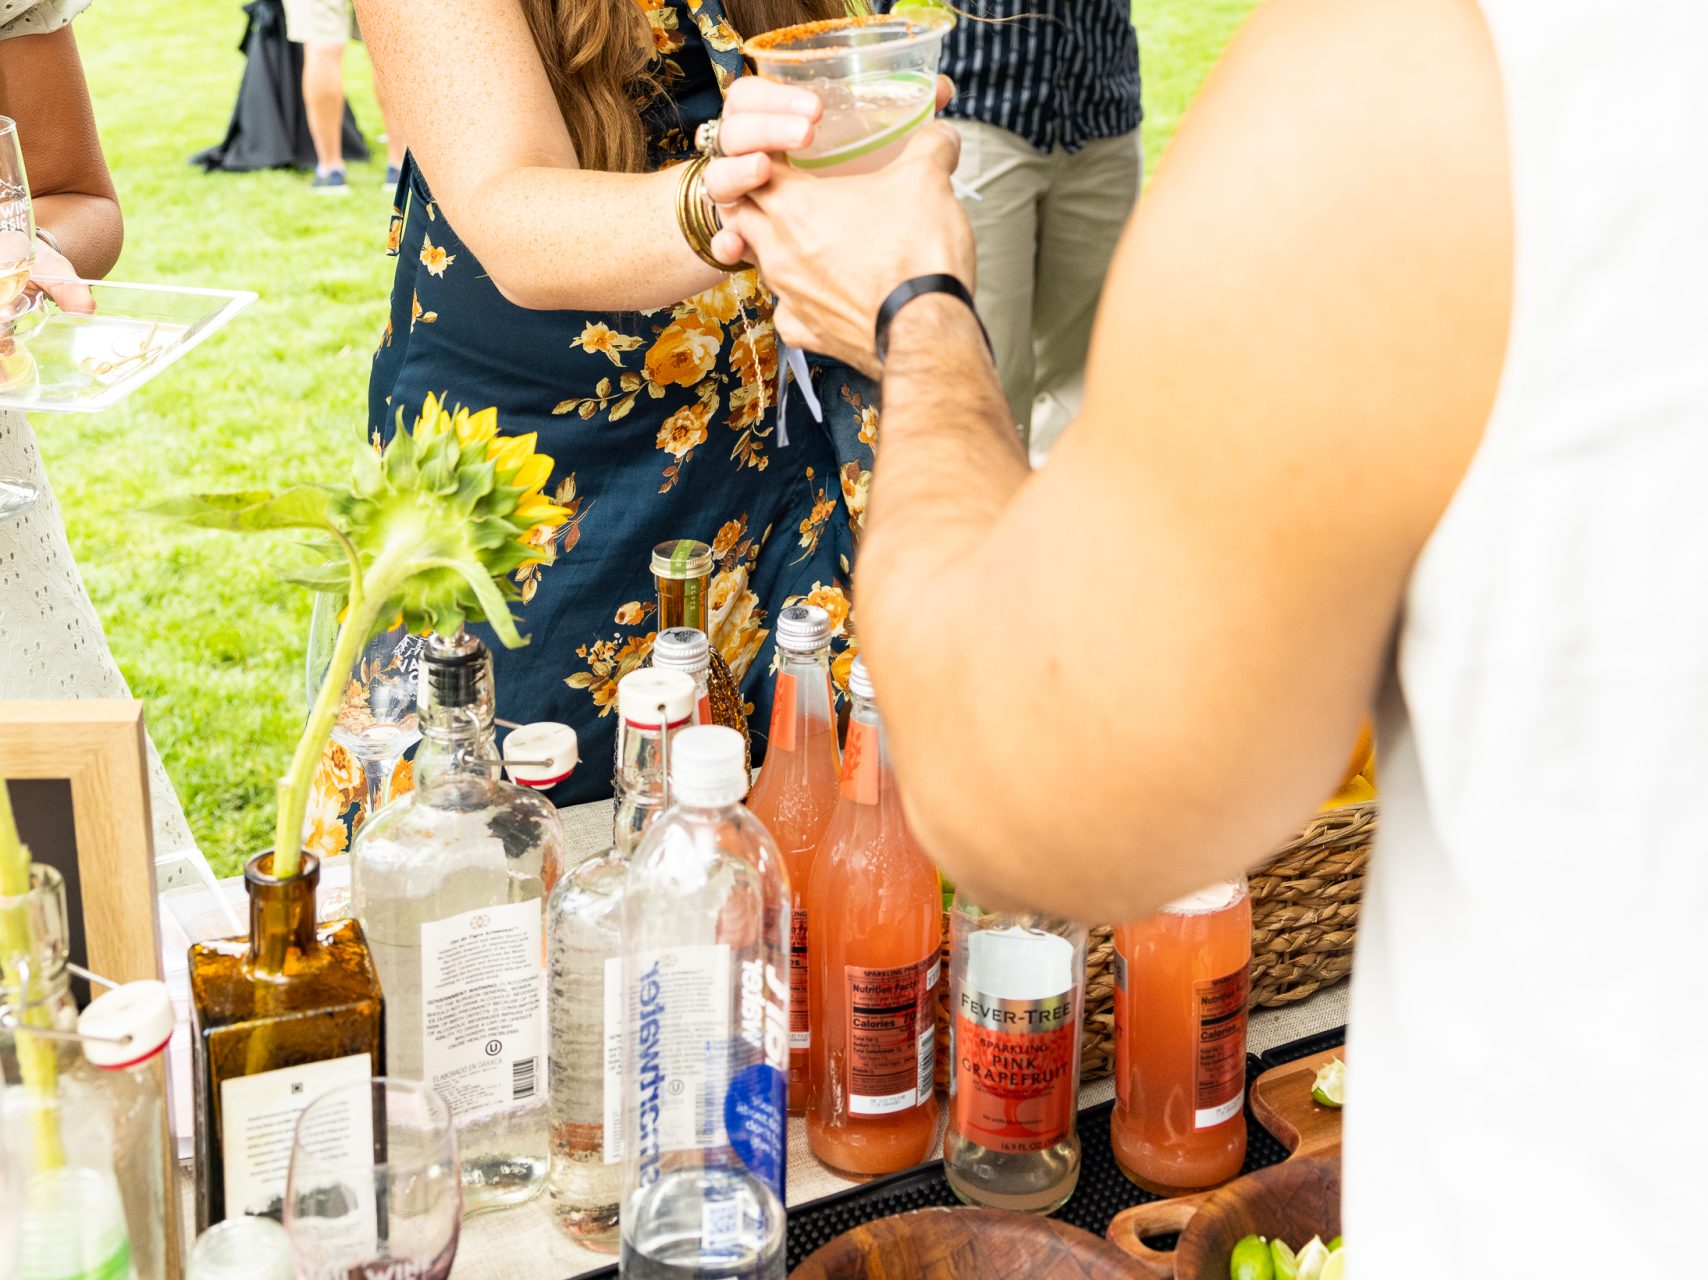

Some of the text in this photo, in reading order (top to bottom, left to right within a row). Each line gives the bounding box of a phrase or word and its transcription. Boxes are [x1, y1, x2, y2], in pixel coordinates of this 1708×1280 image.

[853, 983, 893, 994] Nutrition
[961, 992, 1071, 1025] FEVER-TREE
[853, 1018, 896, 1029] Calories
[980, 1038, 1048, 1055] SPARKLING
[992, 1055, 1036, 1070] PINK
[962, 1058, 1068, 1086] GRAPEFRUIT
